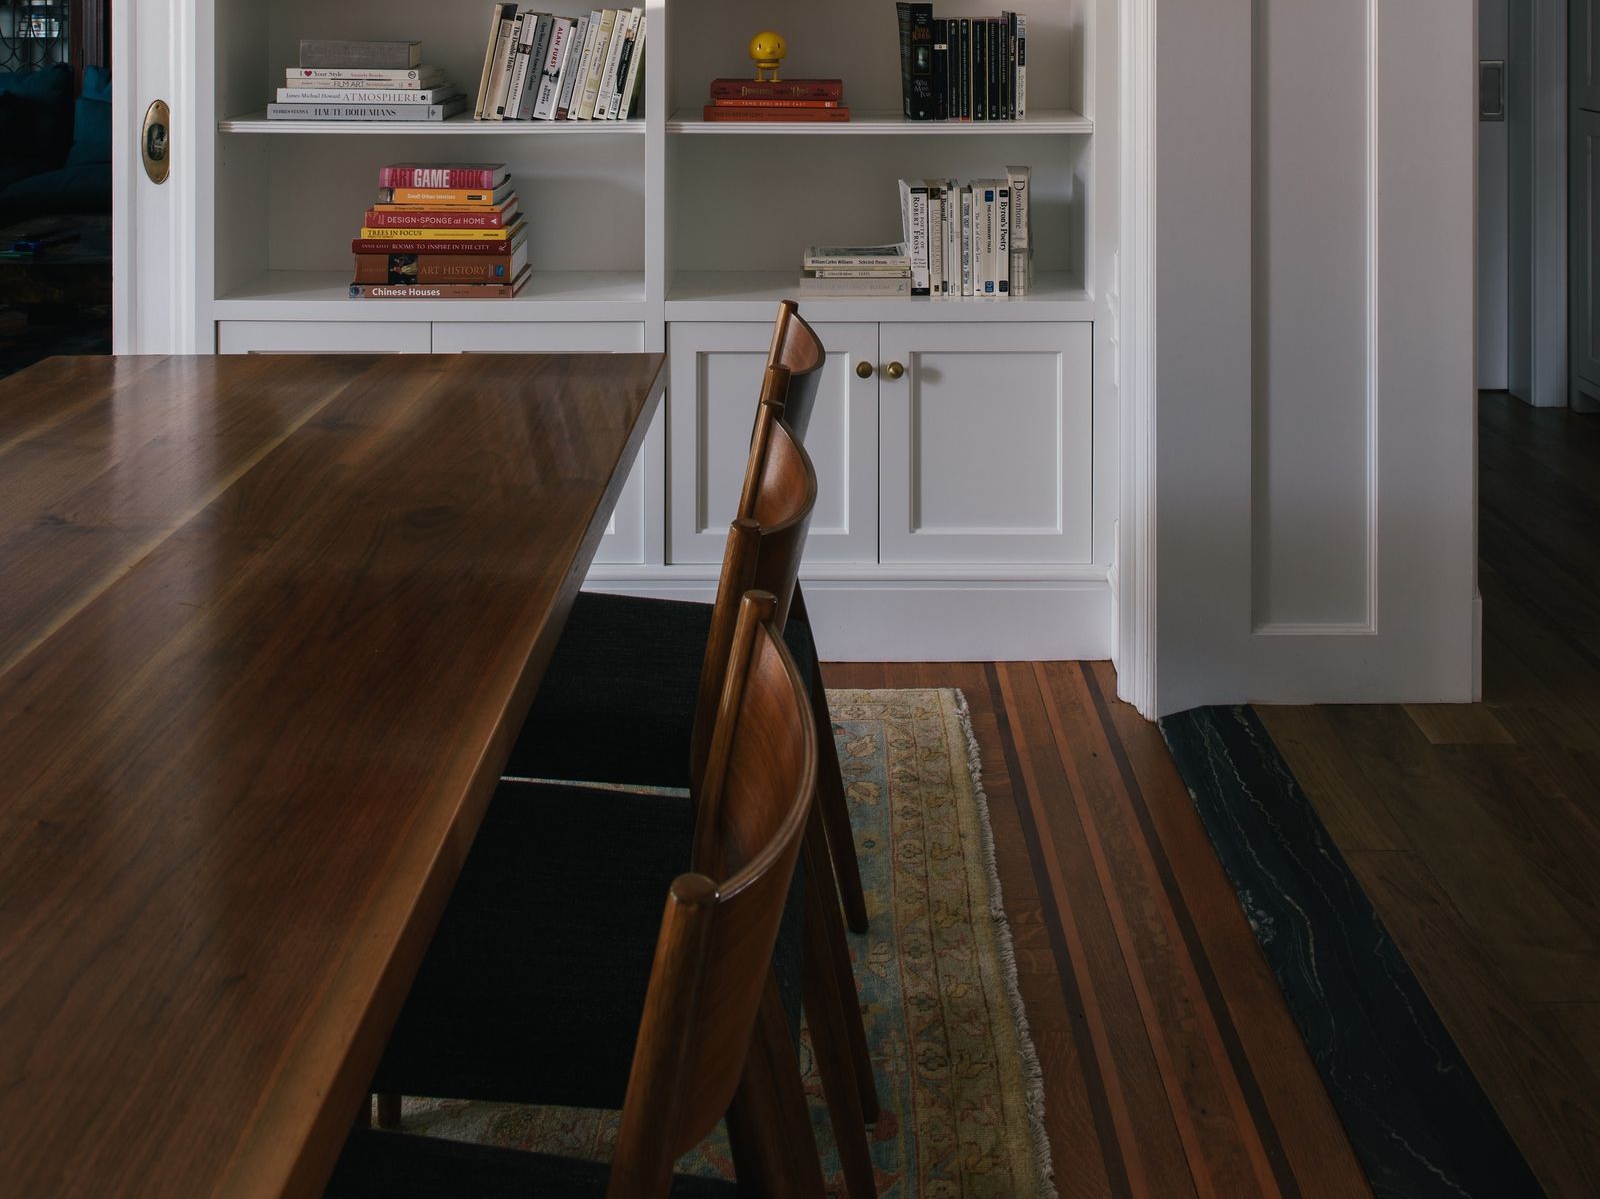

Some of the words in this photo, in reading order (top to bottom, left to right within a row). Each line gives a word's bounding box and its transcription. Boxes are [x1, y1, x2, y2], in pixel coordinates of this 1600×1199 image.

[512, 26, 520, 34] The
[555, 26, 564, 45] ALAN
[508, 36, 518, 55] Double
[506, 56, 515, 72] Helix
[550, 48, 560, 68] FURST
[328, 70, 343, 78] Style
[343, 93, 418, 102] ATMOSPHERE
[314, 108, 344, 116] HAUTE
[345, 108, 397, 117] BOHEMIANS
[414, 168, 450, 188] GAME
[913, 197, 921, 227] ROBERT
[999, 201, 1008, 228] Byron's
[1013, 180, 1026, 230] Downhome
[453, 217, 462, 225] at
[463, 217, 486, 225] HOME
[913, 230, 921, 255] FROST
[920, 241, 925, 249] OF
[999, 228, 1008, 252] Poetry
[934, 245, 942, 275] BLOOM
[420, 266, 441, 276] ART
[443, 265, 487, 276] HISTORY
[371, 287, 408, 296] Chinese
[409, 287, 442, 296] Houses
